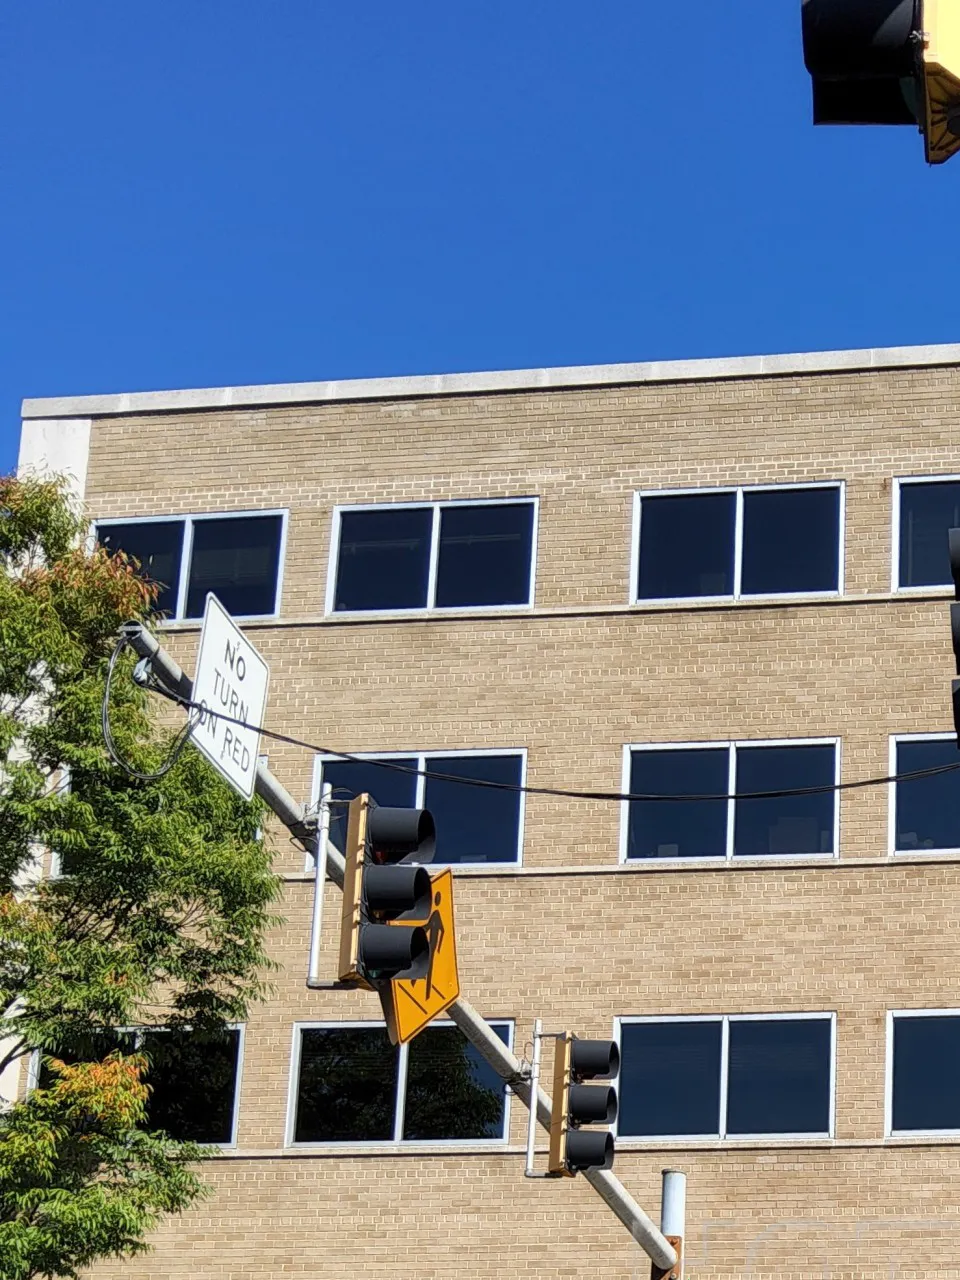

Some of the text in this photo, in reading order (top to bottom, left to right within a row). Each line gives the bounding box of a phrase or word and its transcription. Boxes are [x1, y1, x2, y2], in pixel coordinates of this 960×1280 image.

[224, 639, 247, 682] NO
[213, 668, 250, 730] TURN
[198, 698, 250, 773] ON RED
